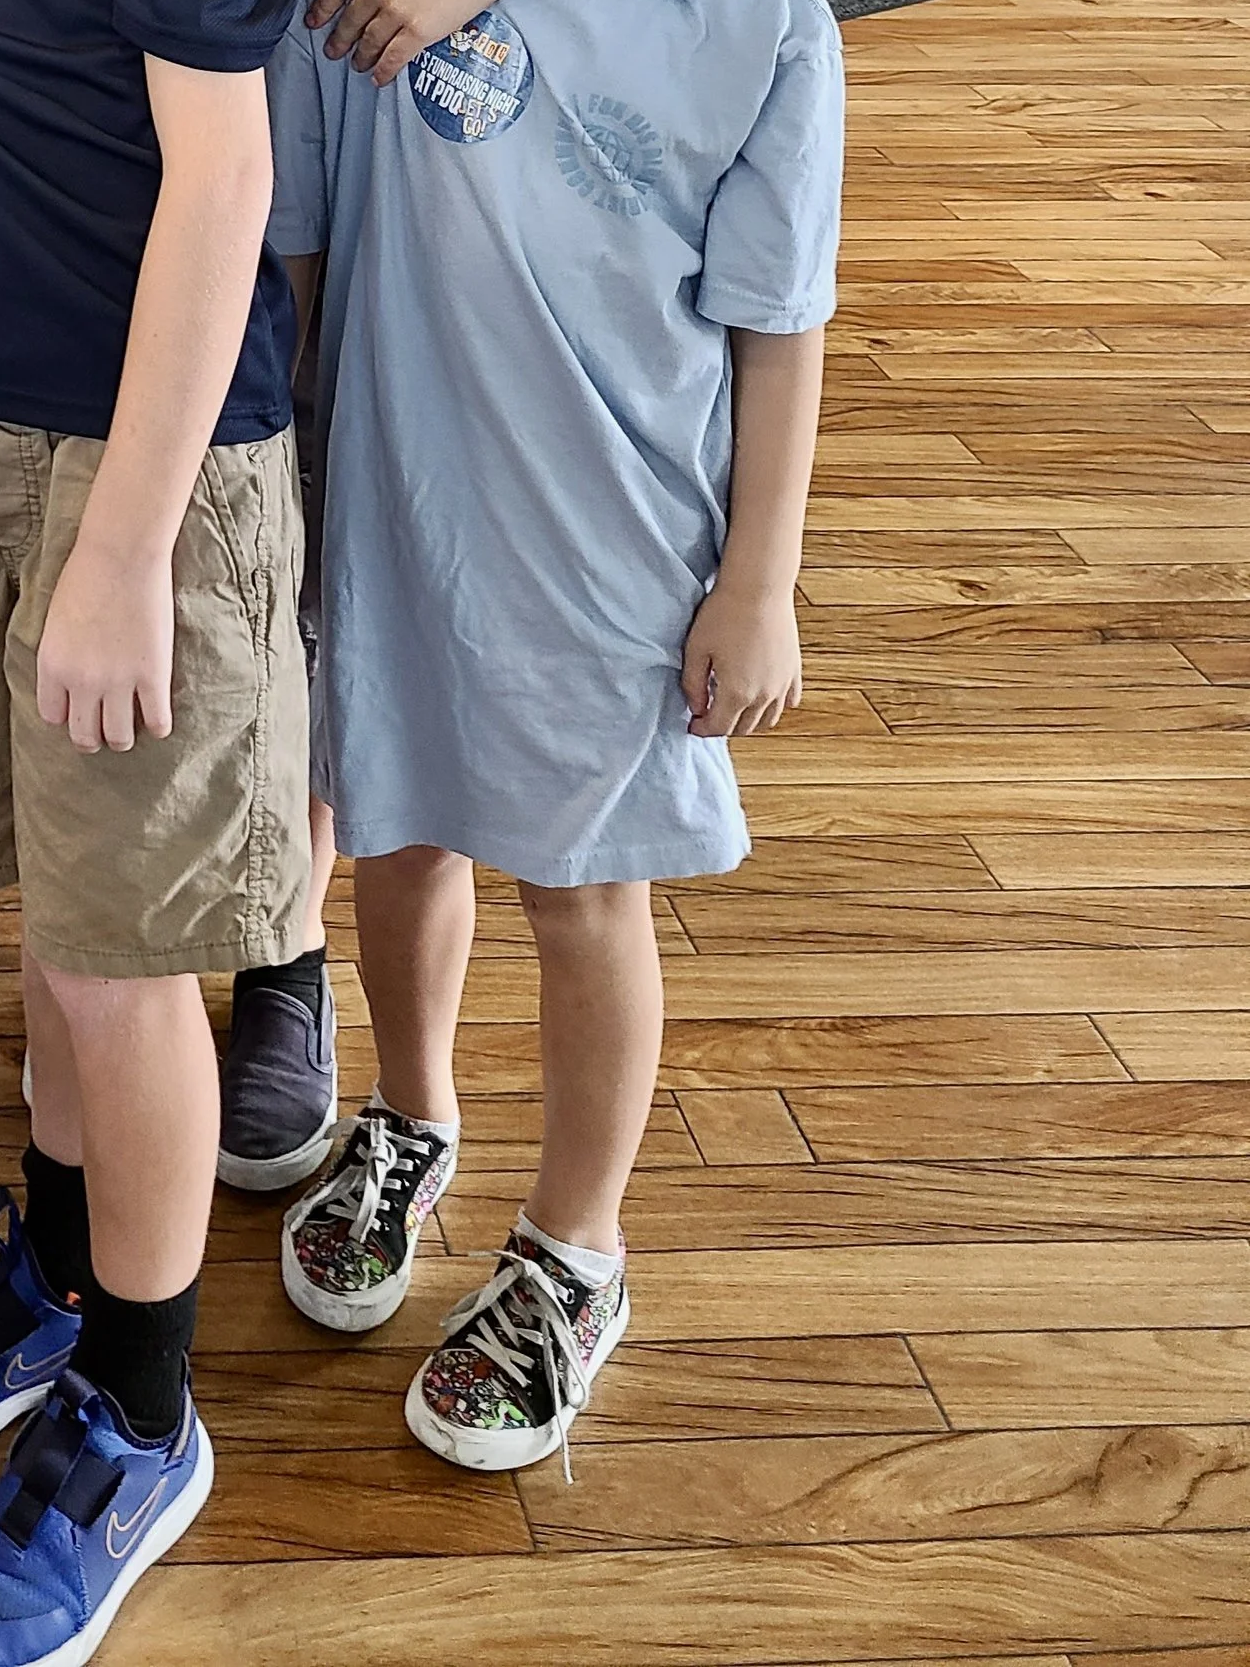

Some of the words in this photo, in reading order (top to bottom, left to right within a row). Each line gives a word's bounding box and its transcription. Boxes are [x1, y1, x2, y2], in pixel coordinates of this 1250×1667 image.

[413, 69, 436, 97] AT
[430, 78, 467, 117] PDQ
[427, 55, 489, 101] FUNDRAISING
[485, 84, 522, 117] NIGHT
[463, 115, 487, 139] GO!
